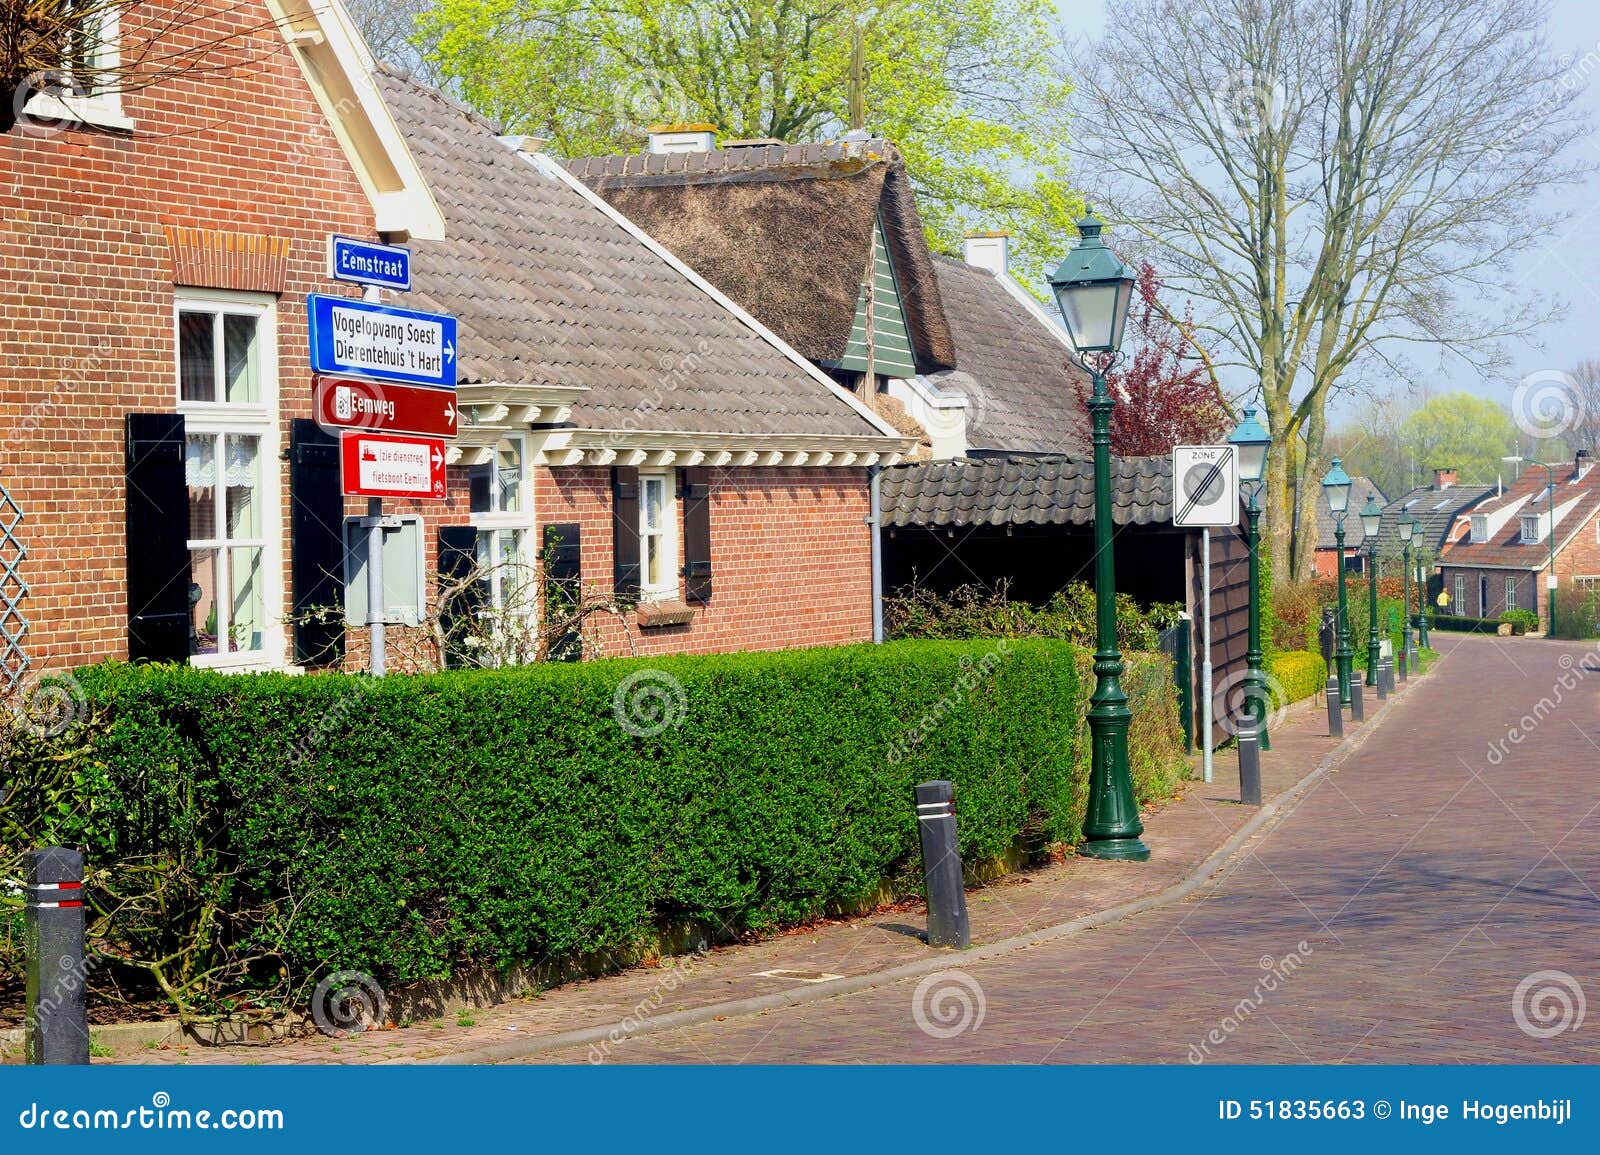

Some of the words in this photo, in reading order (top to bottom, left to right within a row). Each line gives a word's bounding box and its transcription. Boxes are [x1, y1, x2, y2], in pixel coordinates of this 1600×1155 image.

[341, 249, 403, 278] Eemstraat
[333, 311, 404, 345] Vogelopvang
[407, 323, 435, 345] Soest
[335, 339, 405, 367] Dierentehuis
[407, 349, 415, 368] 't
[418, 353, 441, 372] Hart
[351, 392, 395, 421] Eemweg
[1191, 451, 1216, 460] ZONE
